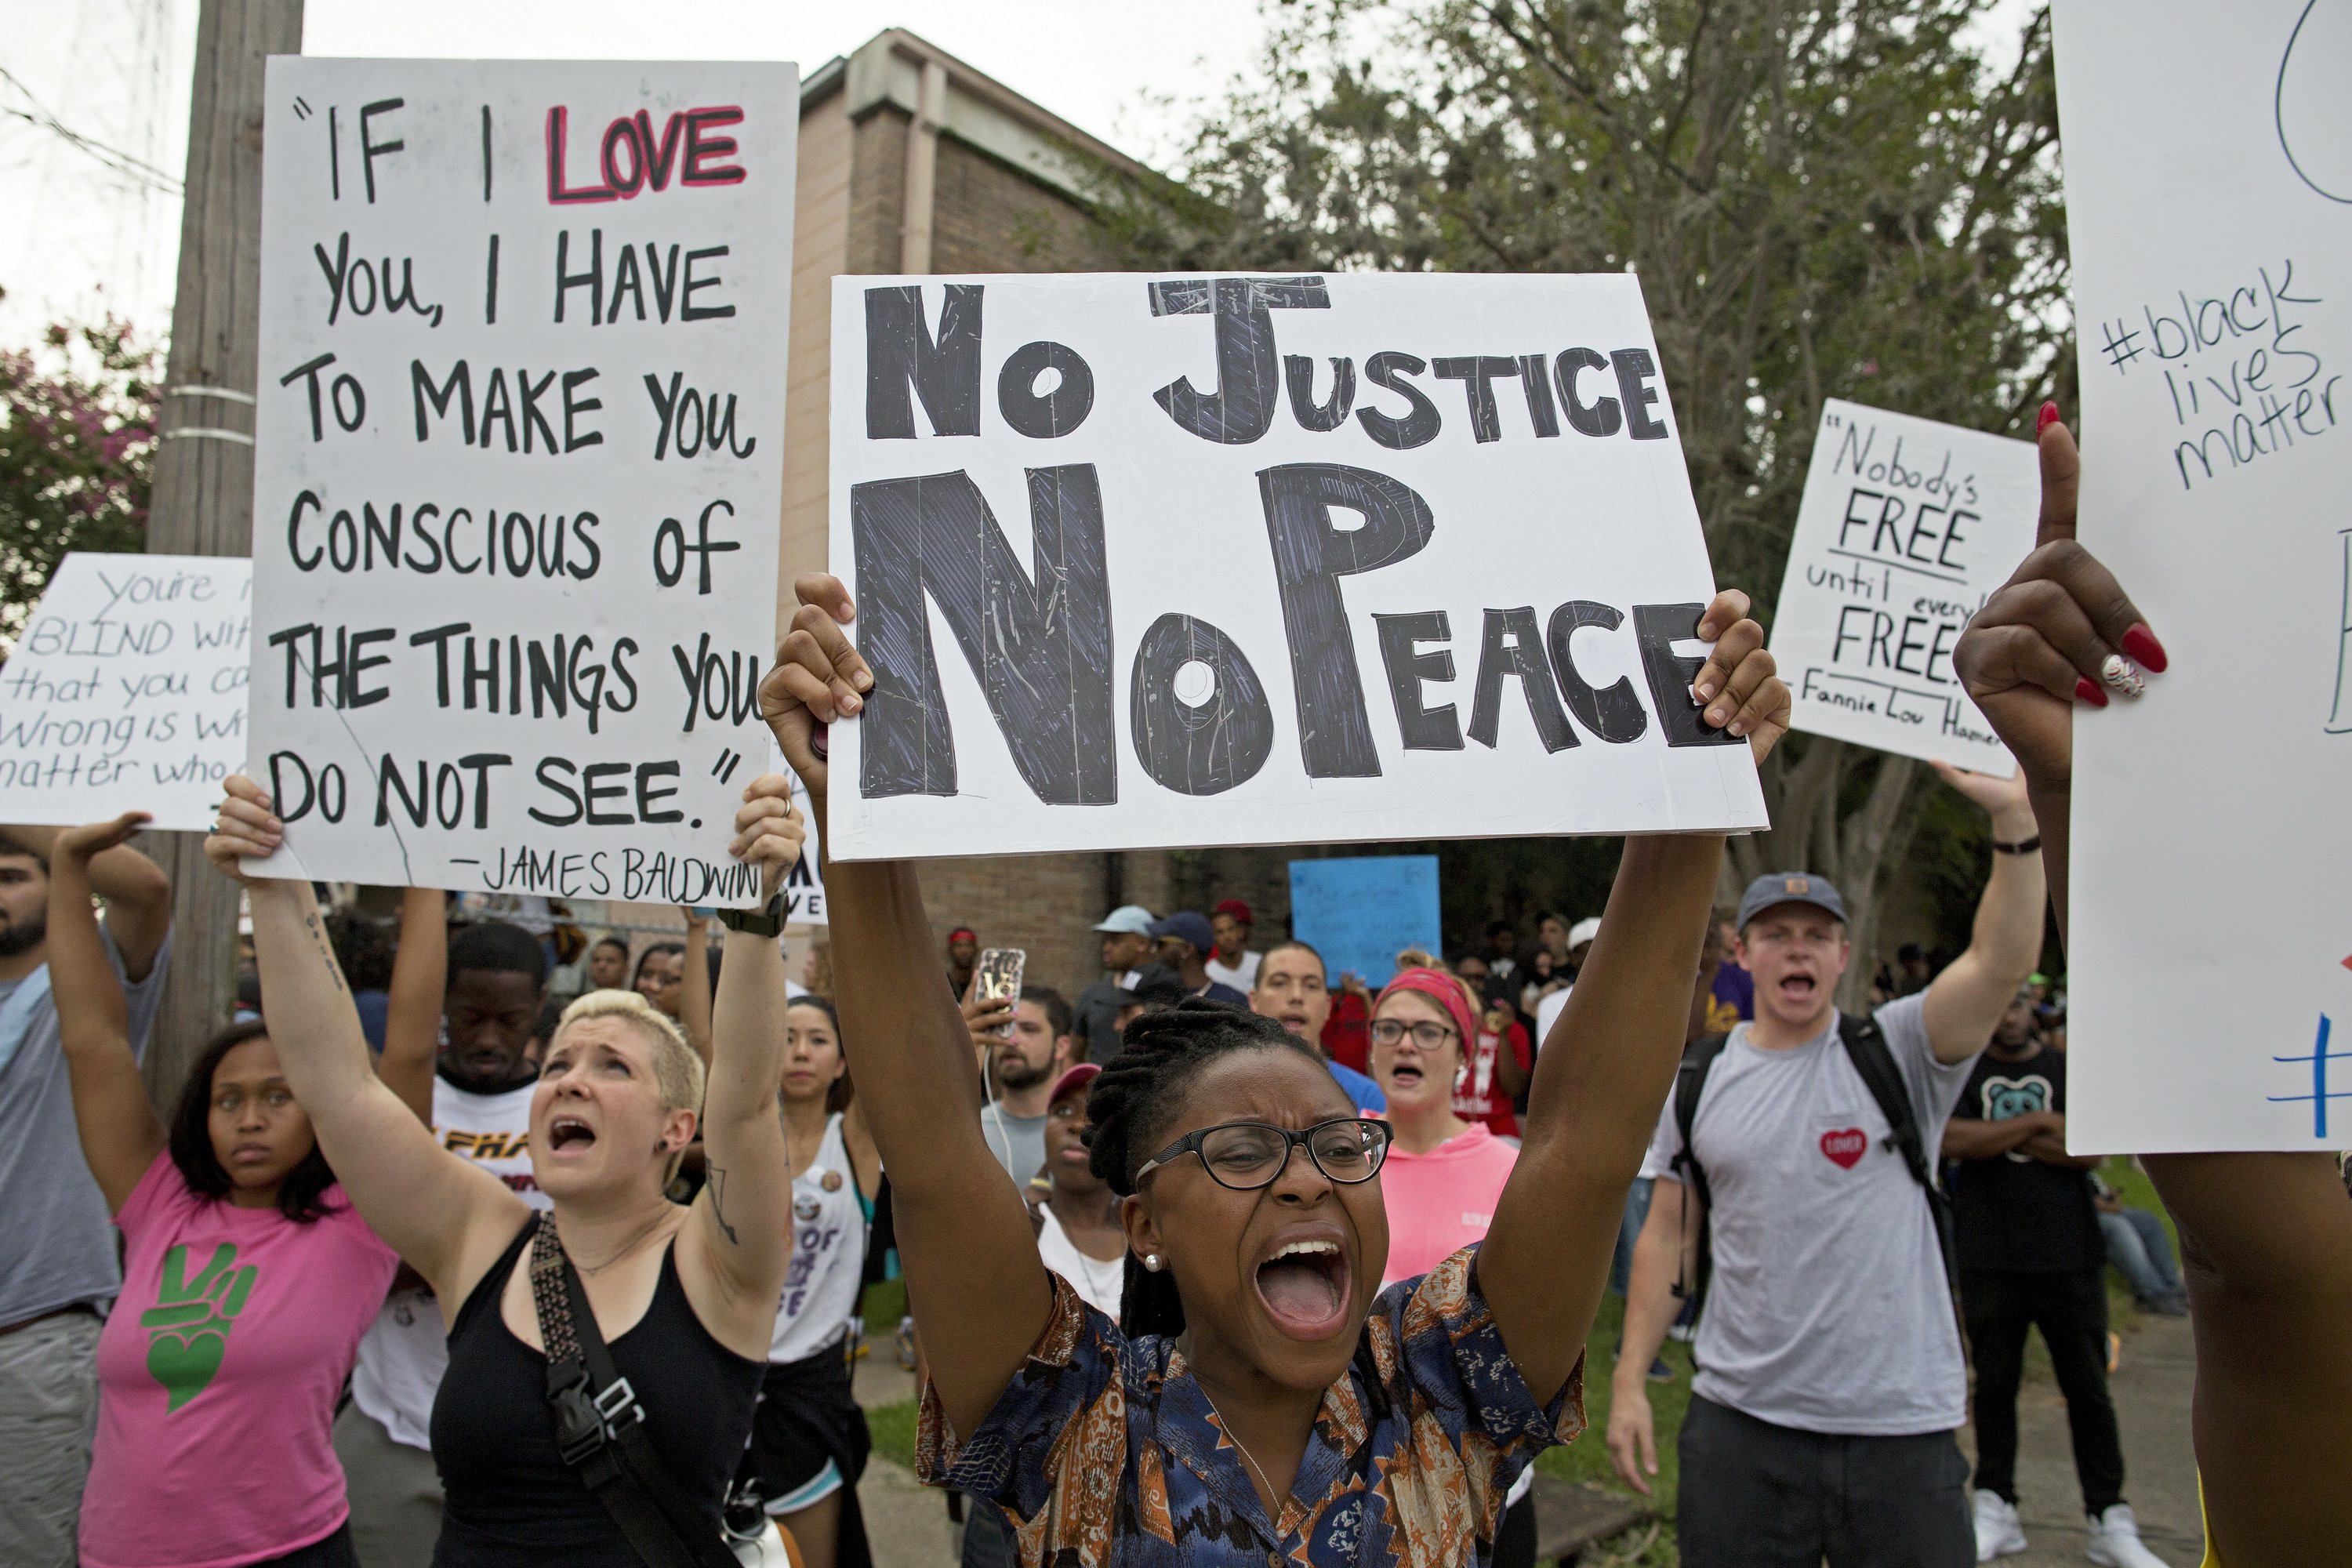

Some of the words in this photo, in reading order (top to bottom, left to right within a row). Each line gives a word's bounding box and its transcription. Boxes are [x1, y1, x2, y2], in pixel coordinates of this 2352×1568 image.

[481, 104, 492, 203] I
[546, 104, 747, 205] LOVE
[485, 234, 499, 325] I
[554, 228, 736, 326] HAVE
[2101, 259, 2324, 376] #black
[279, 352, 366, 442] TO
[411, 358, 604, 456] MAKE
[1147, 274, 1670, 451] JUSTICE
[2163, 325, 2321, 426] lives
[2173, 375, 2343, 491] matter
[287, 488, 601, 580] CONSCIOUS
[1838, 488, 1982, 572] FREE
[1257, 462, 1748, 780] PEACE
[1806, 561, 1891, 604] until
[28, 615, 174, 658] BLIND
[269, 623, 396, 710] THE
[409, 622, 639, 735] THINGS
[5, 666, 103, 703] that
[120, 670, 190, 710] you
[144, 710, 179, 744] is
[1885, 687, 1925, 726] Lou
[153, 753, 227, 785] who
[269, 750, 347, 824] DO
[374, 751, 513, 830] NOT
[622, 847, 759, 906] BALDWIN
